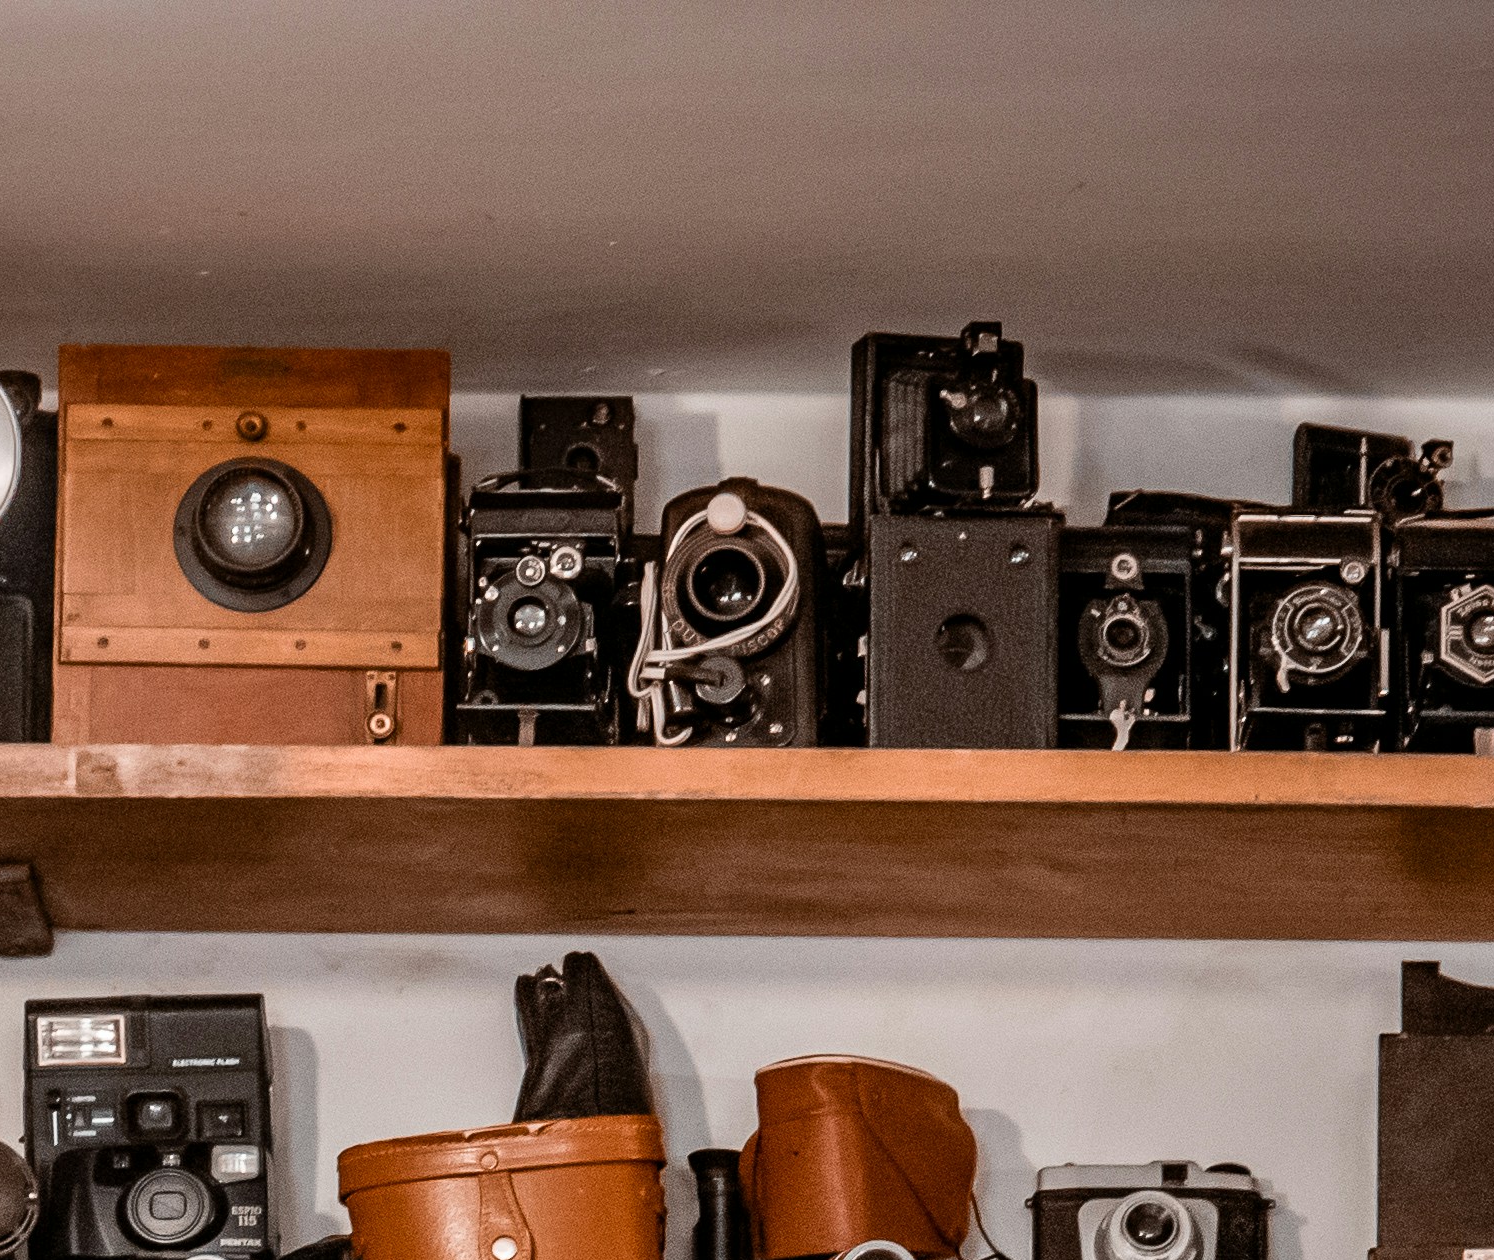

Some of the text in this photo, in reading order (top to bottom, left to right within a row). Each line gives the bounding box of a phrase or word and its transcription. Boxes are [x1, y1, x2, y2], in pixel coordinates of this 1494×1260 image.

[232, 1205, 262, 1215] ESPIO
[238, 1215, 257, 1226] 115
[219, 1238, 262, 1247] PENTAX
